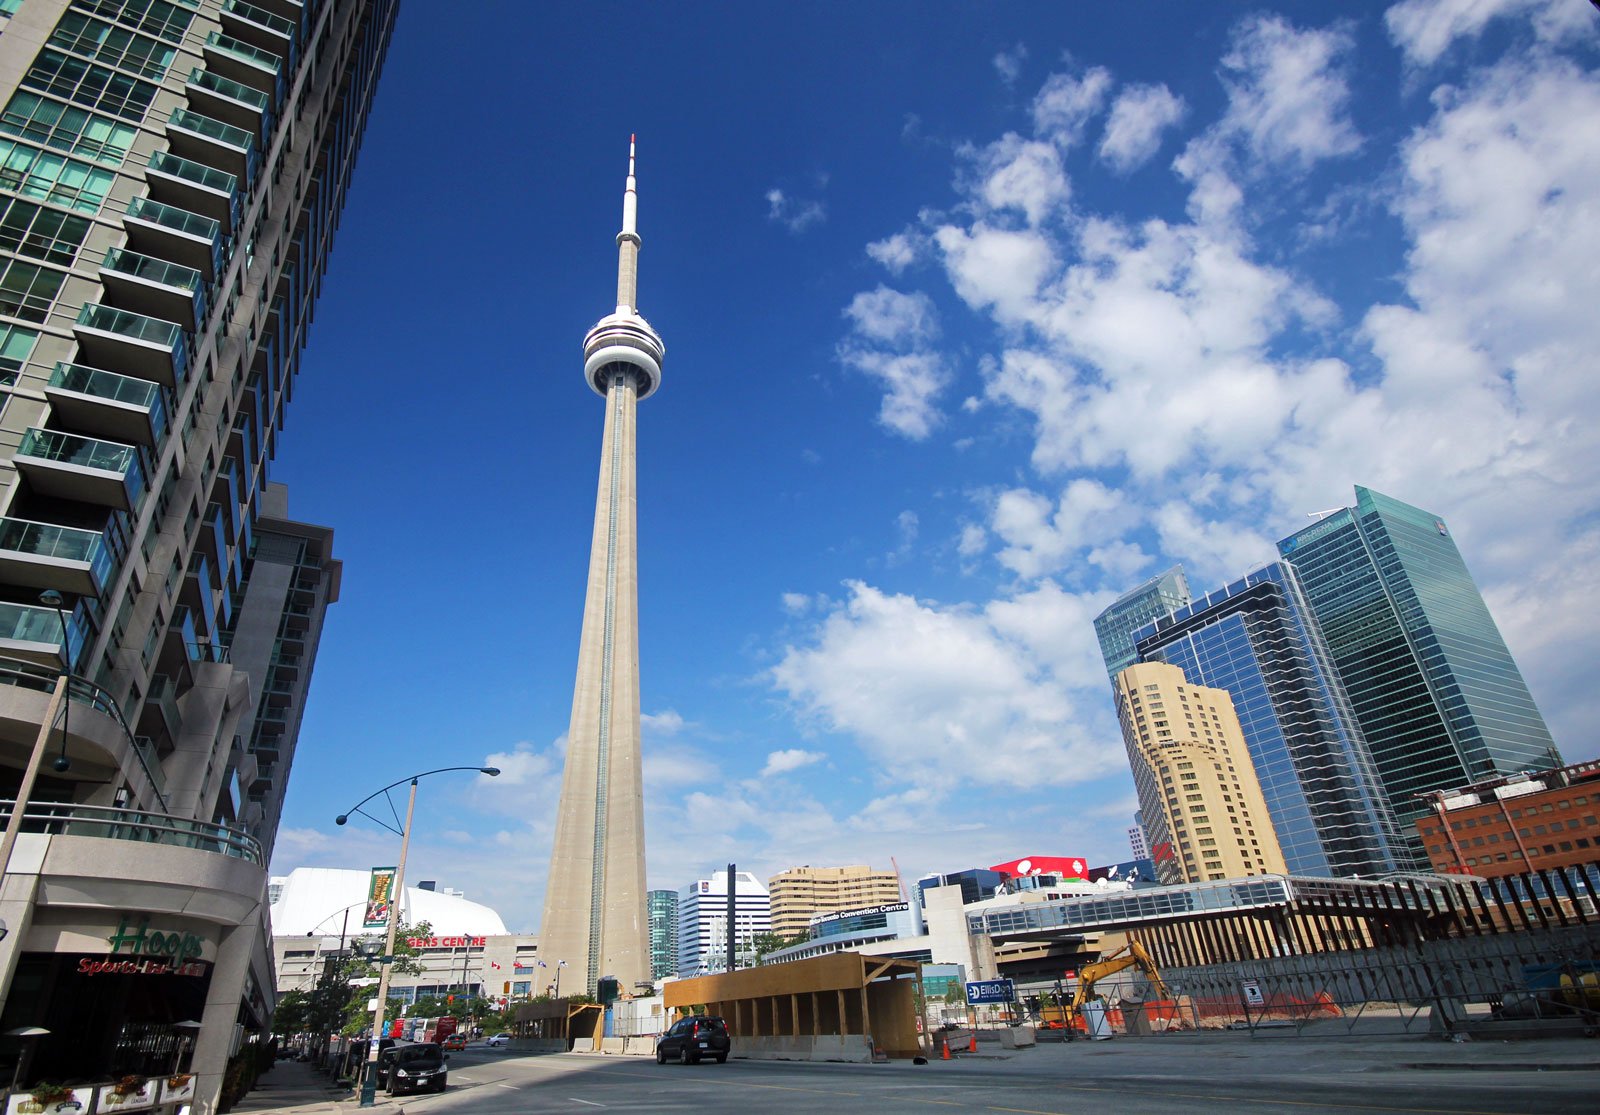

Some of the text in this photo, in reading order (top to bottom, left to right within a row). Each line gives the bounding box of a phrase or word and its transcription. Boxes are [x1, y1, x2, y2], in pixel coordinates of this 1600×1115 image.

[840, 906, 879, 919] Convention
[880, 903, 908, 913] Centre
[109, 913, 205, 967] Hoops
[402, 937, 439, 948] GERS
[78, 958, 137, 976] Sports
